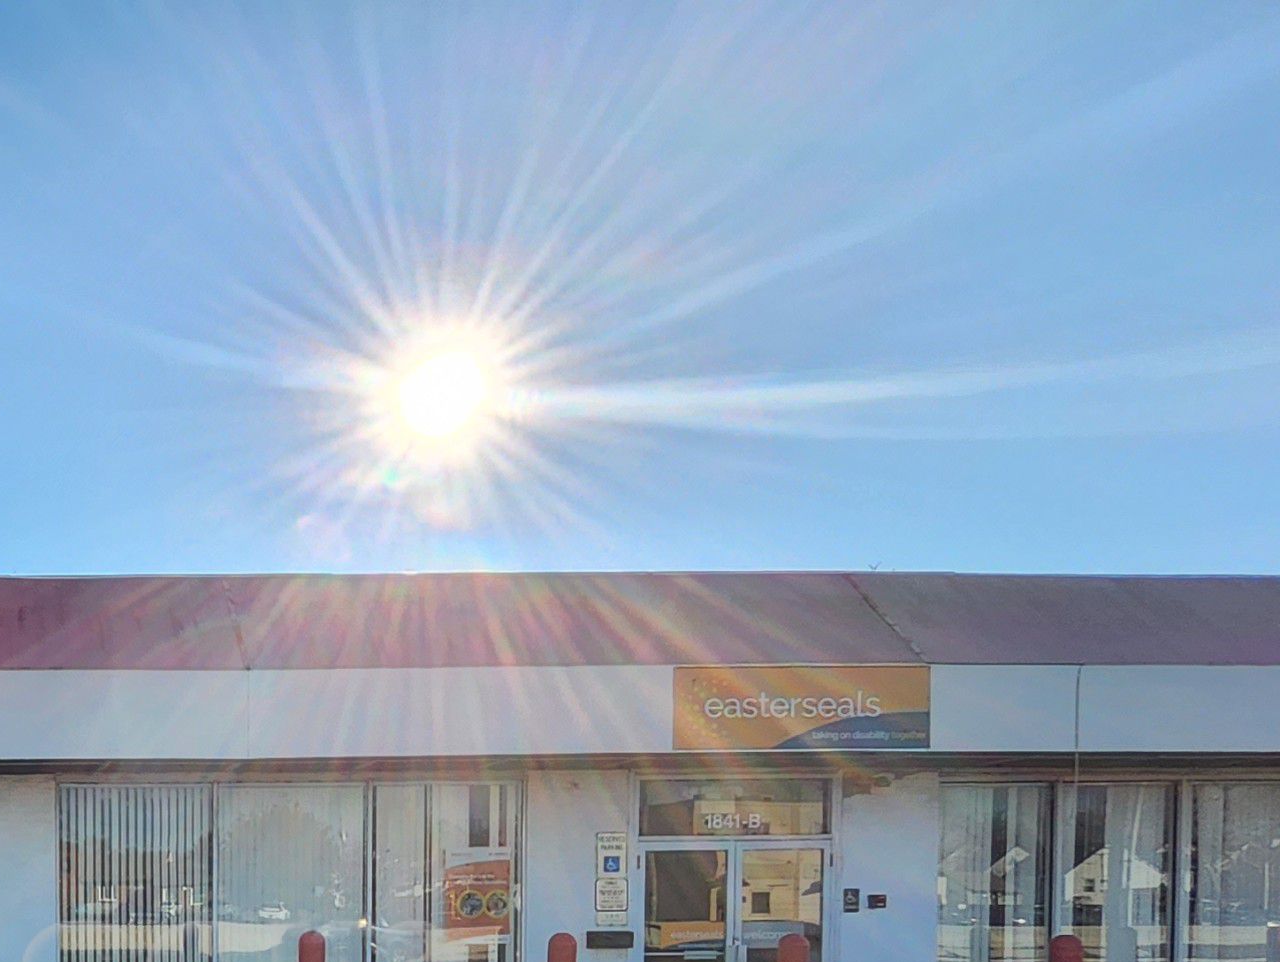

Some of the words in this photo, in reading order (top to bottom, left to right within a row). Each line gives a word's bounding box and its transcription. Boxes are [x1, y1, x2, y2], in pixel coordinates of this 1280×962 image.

[704, 690, 881, 718] easterseals
[812, 730, 839, 742] taking
[840, 732, 852, 741] on
[852, 730, 889, 742] disability
[705, 813, 761, 829] 1841-B
